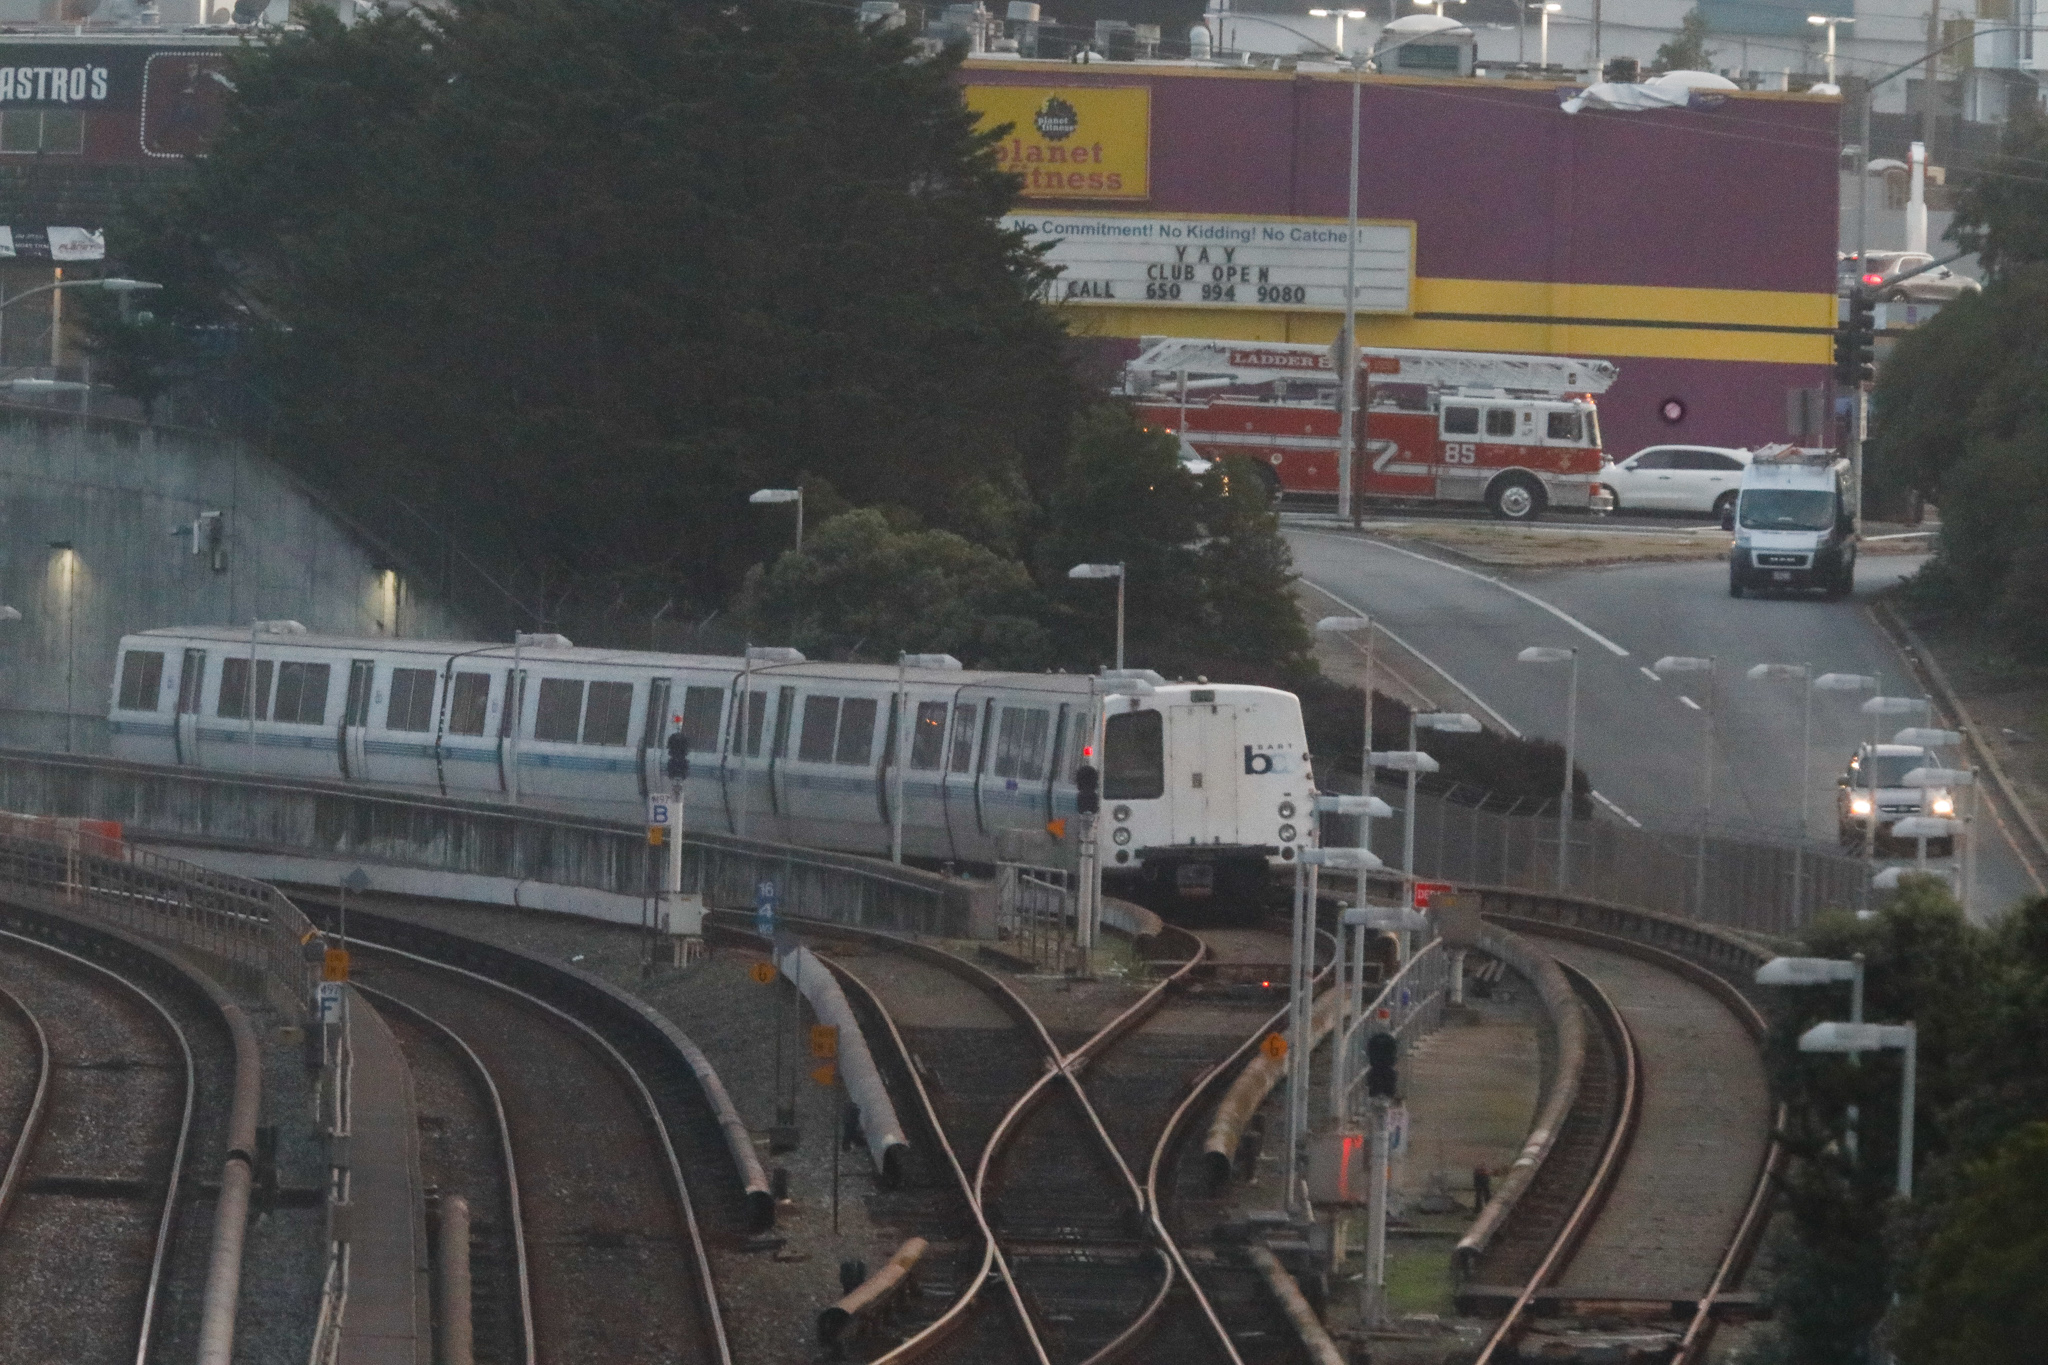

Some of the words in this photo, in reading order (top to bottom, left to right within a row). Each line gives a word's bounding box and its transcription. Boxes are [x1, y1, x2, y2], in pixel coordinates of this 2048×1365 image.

[1009, 164, 1122, 190] itness
[1042, 221, 1152, 237] Commitment!
[1159, 225, 1182, 238] No
[1187, 225, 1256, 243] Kidding!
[1263, 228, 1285, 241] No
[1290, 228, 1362, 243] Catche!
[1147, 264, 1195, 281] CLUB
[1212, 266, 1269, 283] OPEN
[1067, 280, 1114, 298] CALL
[1146, 282, 1181, 299] 650
[1202, 284, 1236, 301] 994
[1257, 286, 1306, 303] 9080
[1233, 353, 1313, 368] LADDER
[1445, 443, 1476, 464] 85
[653, 804, 668, 823] B
[760, 882, 774, 897] 16
[760, 903, 773, 918] 4
[321, 997, 339, 1020] F
